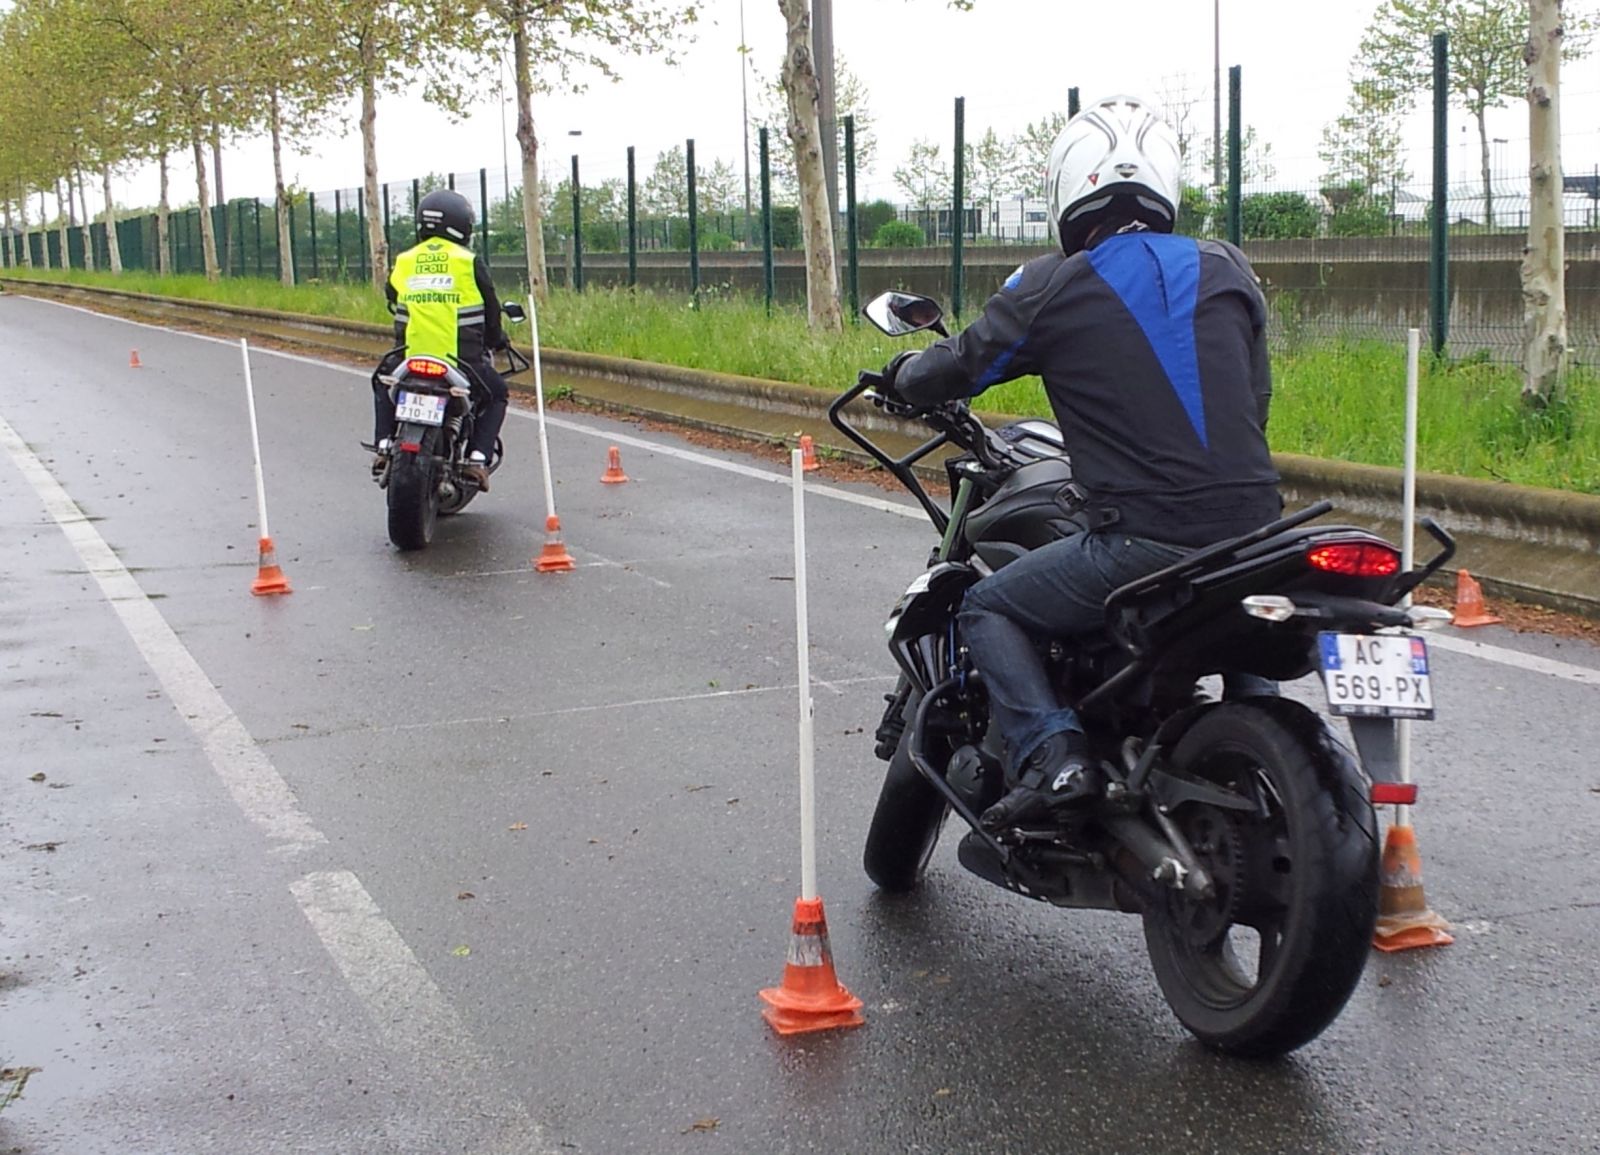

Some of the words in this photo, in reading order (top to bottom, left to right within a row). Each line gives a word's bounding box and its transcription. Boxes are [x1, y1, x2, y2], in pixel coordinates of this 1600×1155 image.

[416, 253, 448, 263] MOTO
[416, 264, 448, 274] ECOLE
[412, 396, 424, 406] AL
[1356, 640, 1383, 665] AC
[1334, 674, 1425, 703] 569-PX
